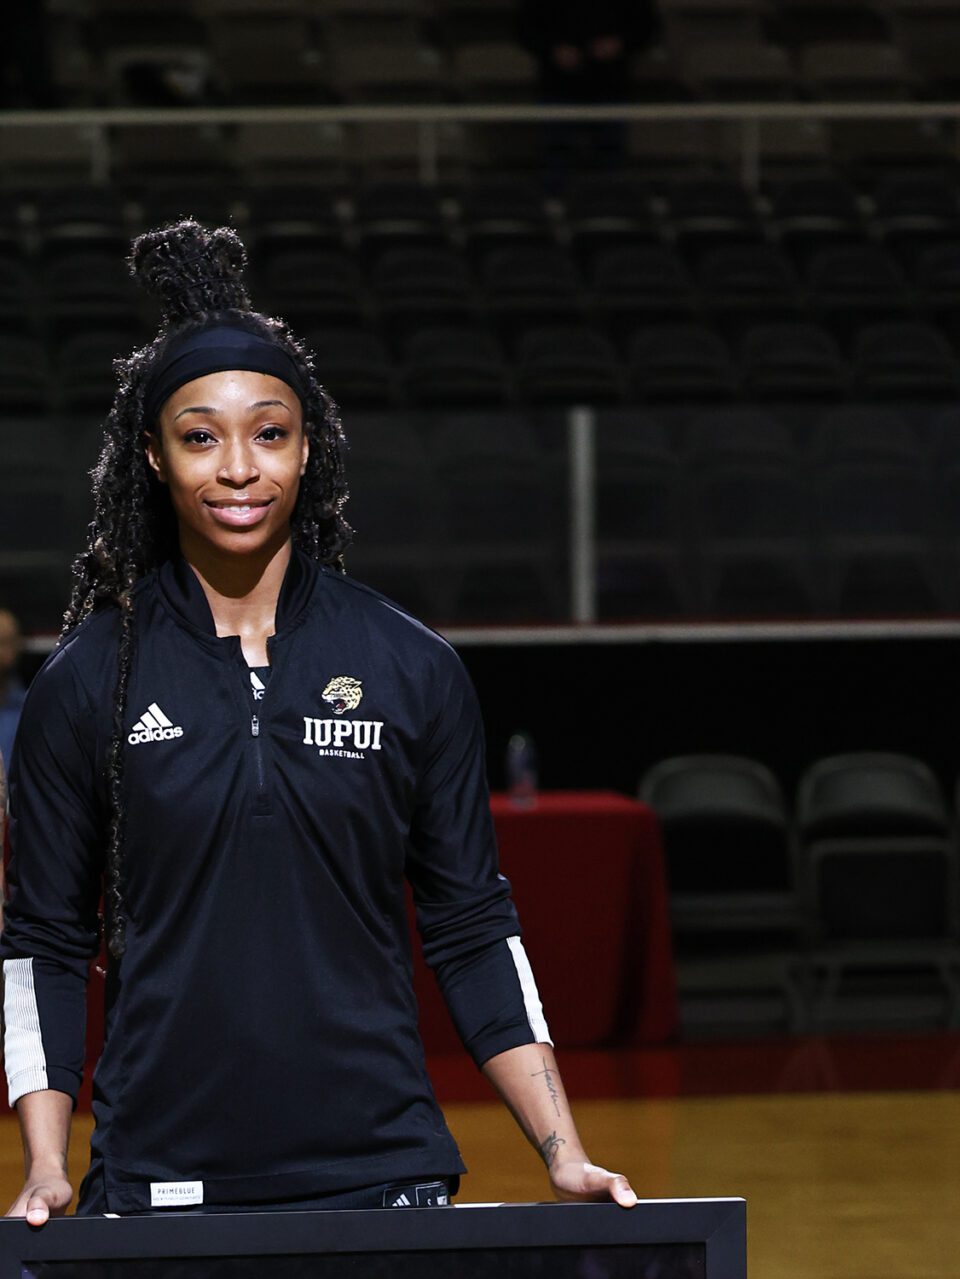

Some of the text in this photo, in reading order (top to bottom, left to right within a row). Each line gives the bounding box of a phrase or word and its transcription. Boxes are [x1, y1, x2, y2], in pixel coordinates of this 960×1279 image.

[128, 724, 184, 745] adidas
[303, 717, 384, 750] IUPUI
[319, 749, 365, 760] BASKETBALL
[157, 1187, 195, 1195] PRIMEBLUE
